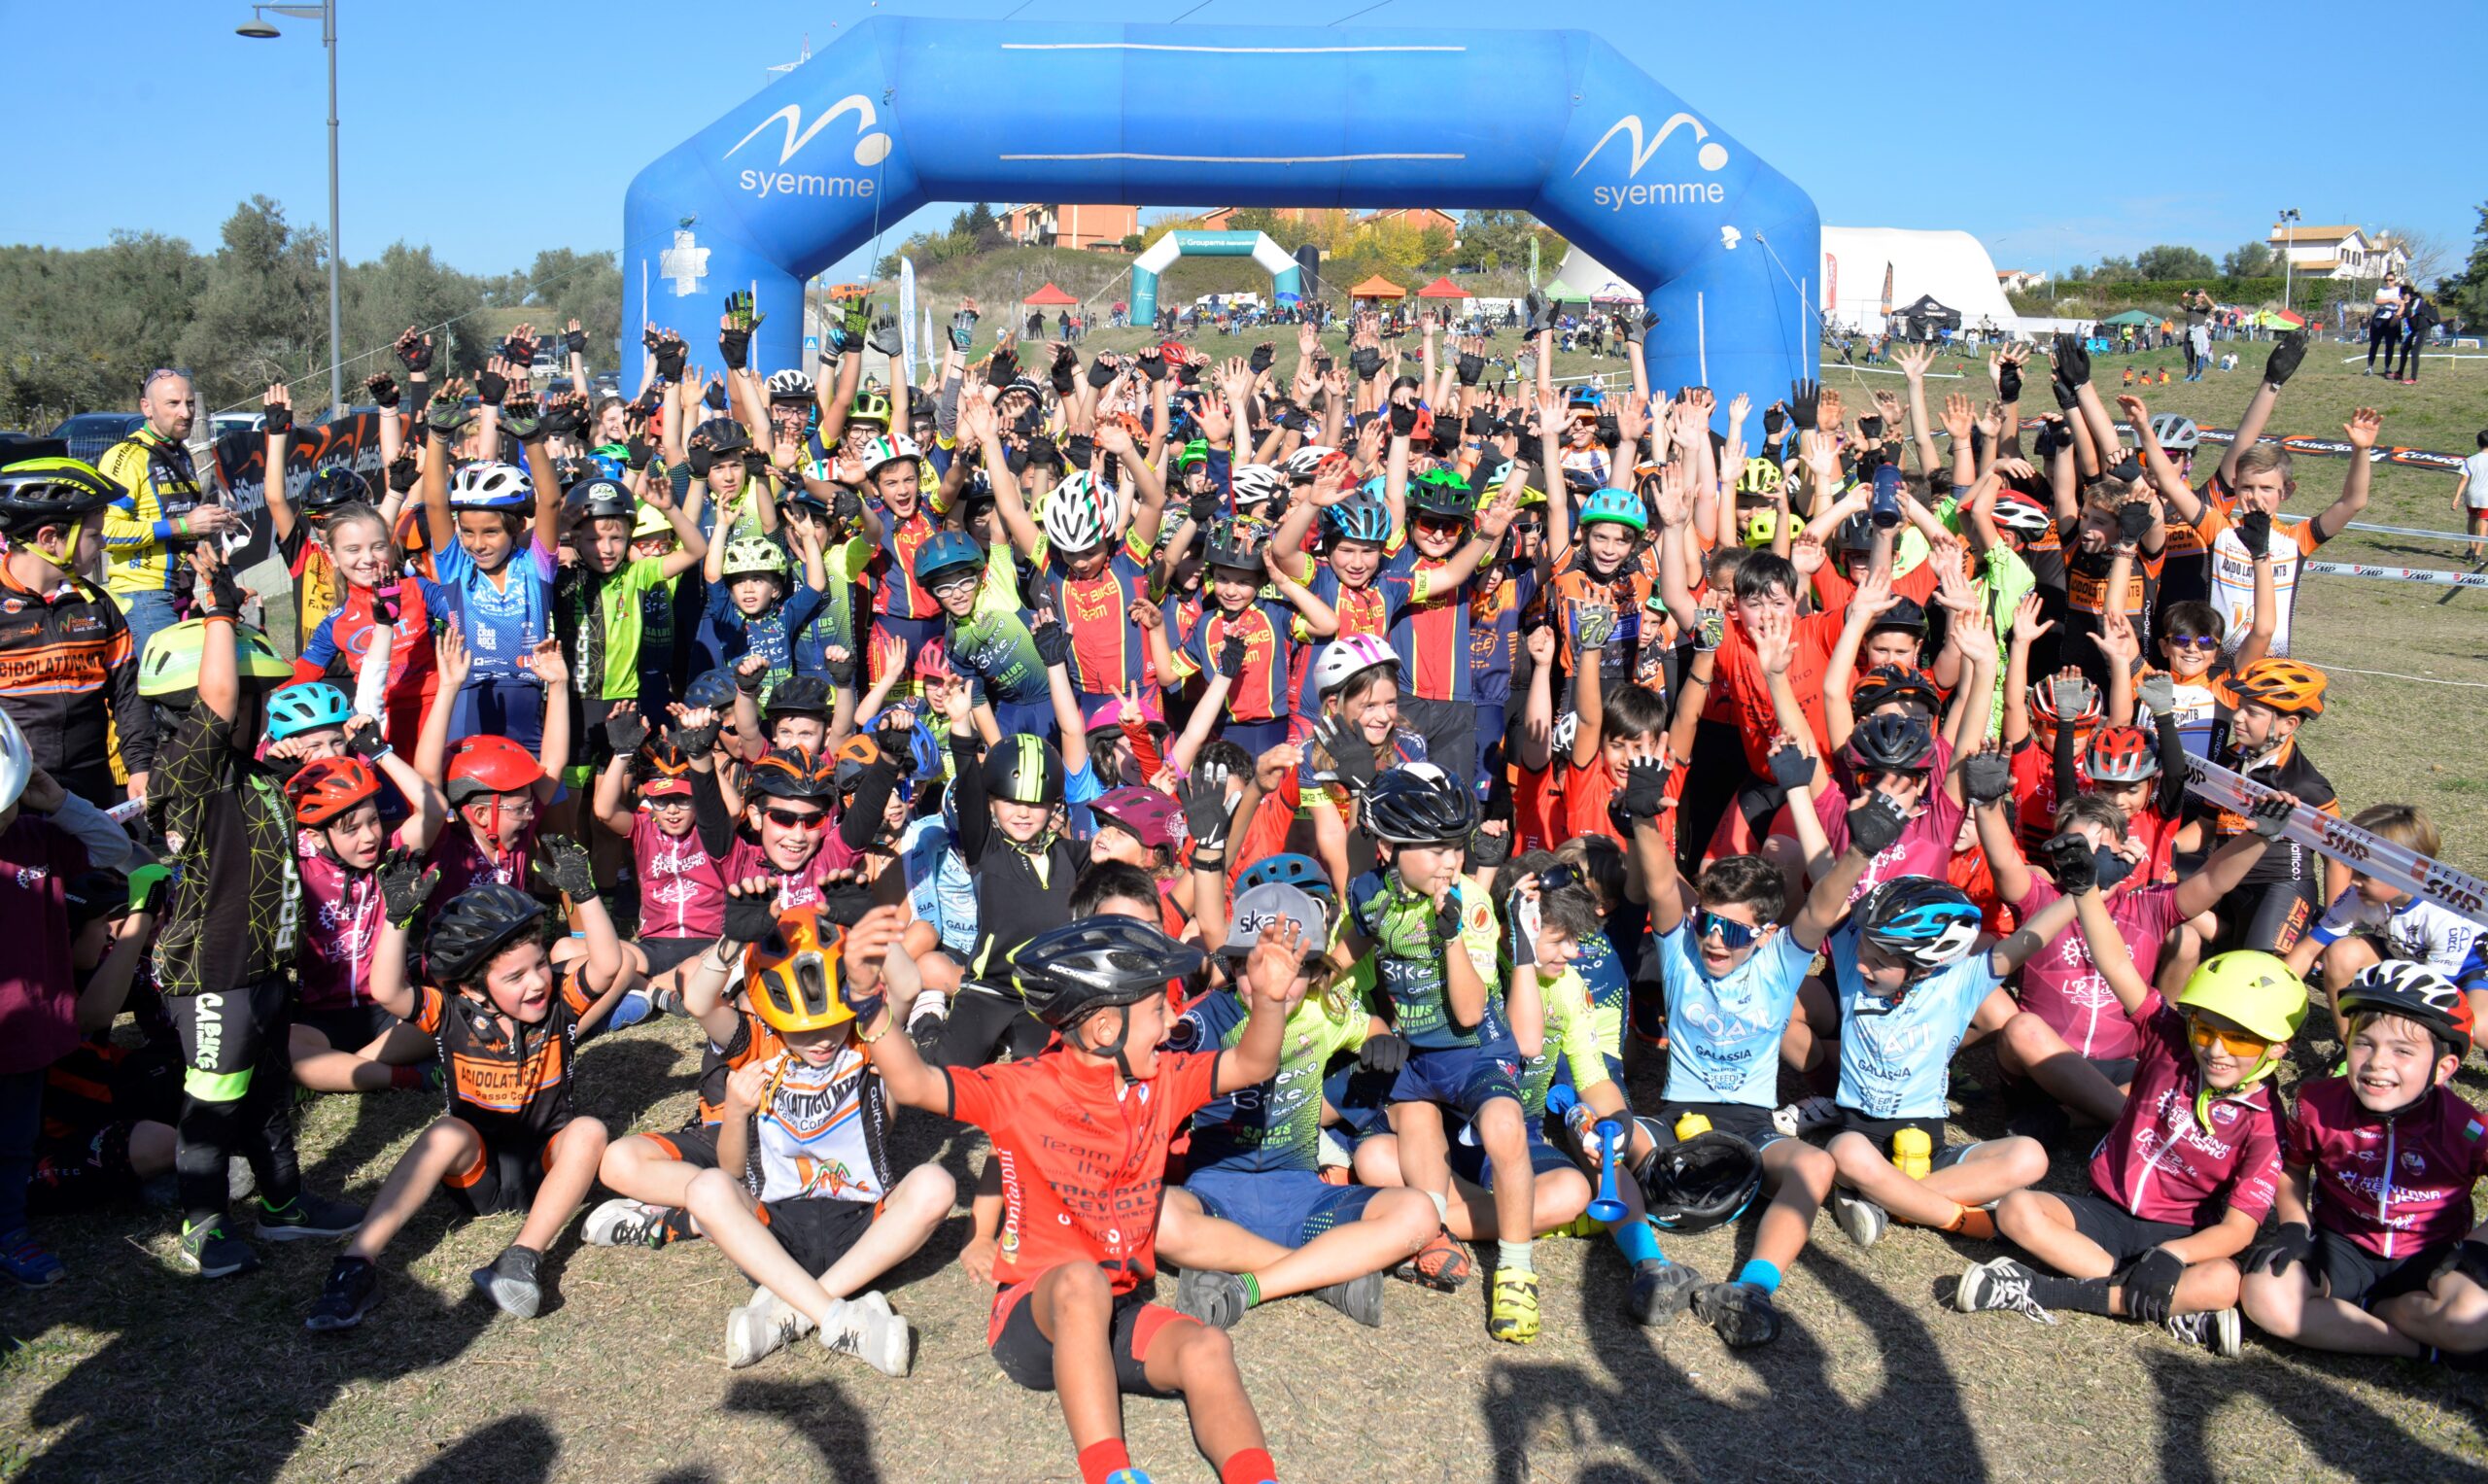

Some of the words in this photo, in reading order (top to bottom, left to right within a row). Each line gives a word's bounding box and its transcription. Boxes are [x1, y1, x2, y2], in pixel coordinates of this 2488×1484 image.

[740, 169, 875, 199] syemme
[1593, 182, 1725, 212] syemme
[2273, 565, 2287, 576] MTB
[2406, 572, 2434, 581] SMP
[1089, 581, 1119, 604] BIKE
[1076, 604, 1108, 622] TEAM
[2321, 831, 2370, 862] SMP
[2327, 818, 2375, 846] SELLE
[2430, 865, 2488, 897] SELLE
[2423, 880, 2482, 914] SMP
[1695, 1045, 1752, 1062] GALASSIA
[1040, 1133, 1111, 1163] Team
